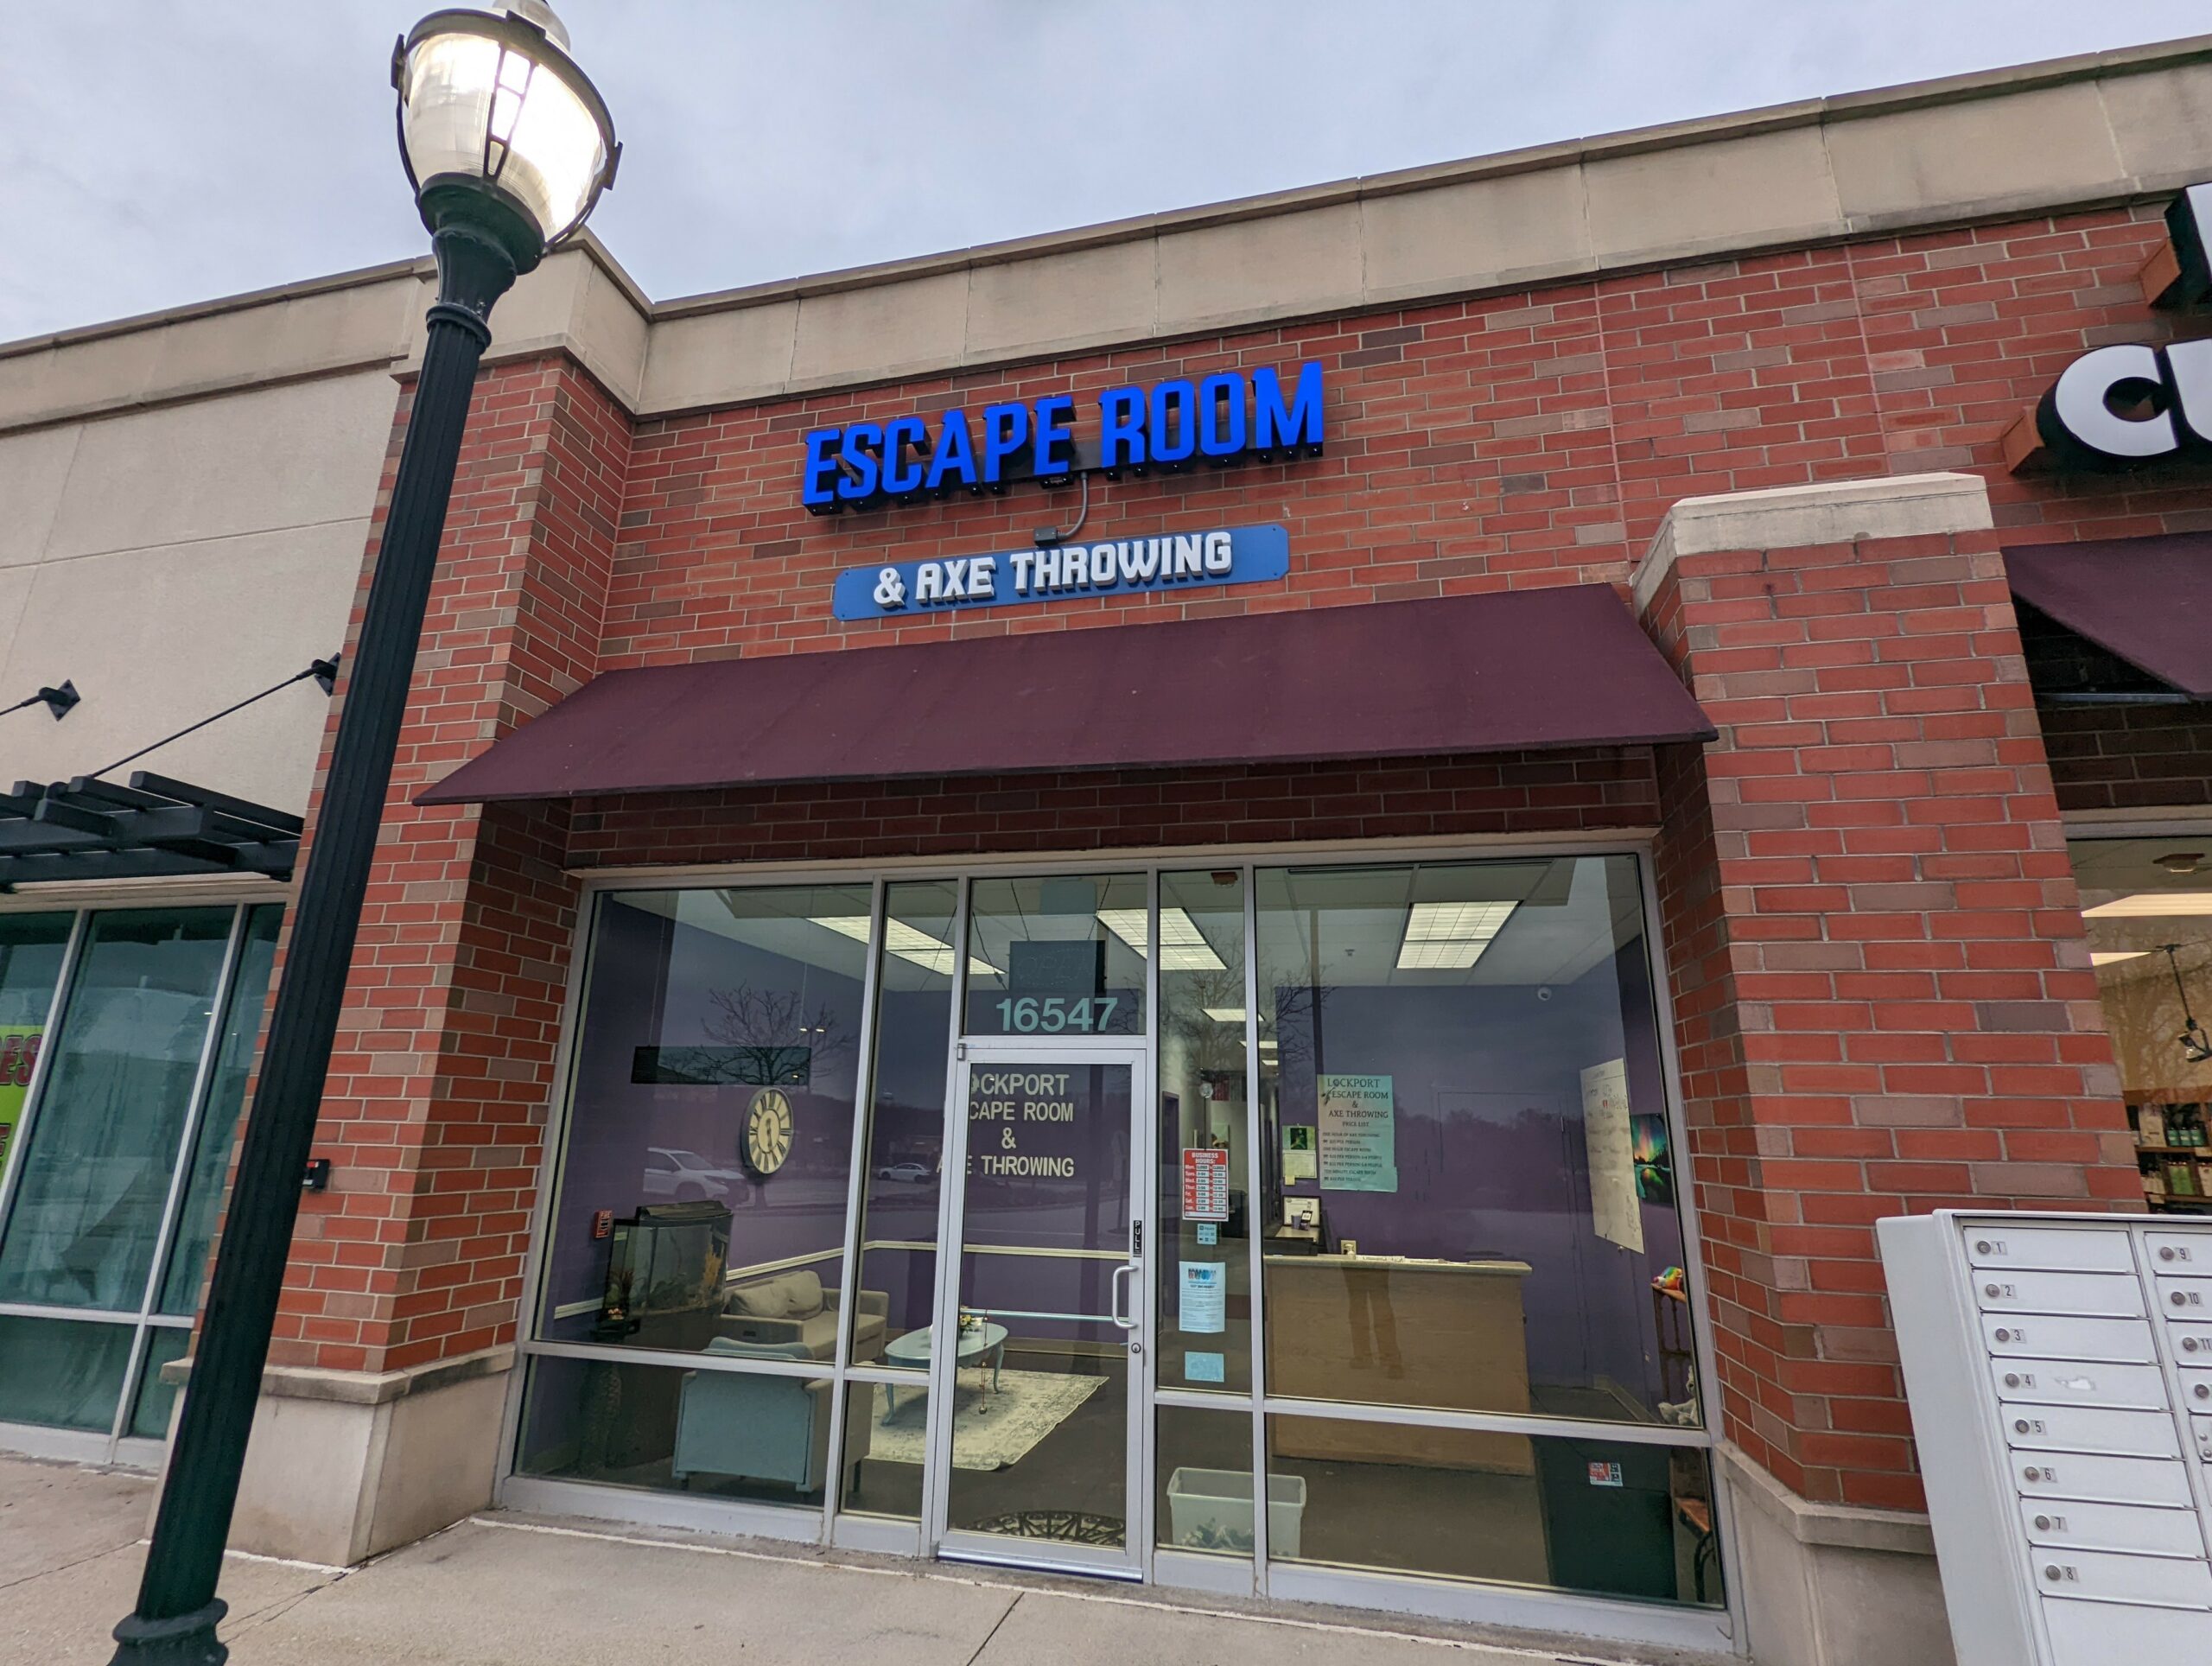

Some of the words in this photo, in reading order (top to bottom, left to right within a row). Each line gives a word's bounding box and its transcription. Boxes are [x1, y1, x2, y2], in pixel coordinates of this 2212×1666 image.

[803, 395, 1075, 508] ESCAPE
[1098, 361, 1324, 468] ROOM
[872, 566, 906, 607] &
[915, 556, 996, 604] AXE
[1009, 531, 1233, 595] THROWING
[996, 997, 1118, 1033] 16547
[970, 1073, 1070, 1096] OCKPORT
[1327, 1078, 1381, 1088] LOCKPORT
[1332, 1091, 1362, 1099] ESCAPE
[969, 1101, 1016, 1121] CAPE
[1023, 1102, 1074, 1122] ROOM
[1345, 1110, 1389, 1119] THROWING
[1001, 1127, 1017, 1149] &
[981, 1155, 1074, 1177] THROWING
[2179, 1248, 2186, 1260] 9
[2005, 1285, 2012, 1296] 2
[2189, 1293, 2199, 1305] 10
[2014, 1329, 2021, 1340] 3
[2024, 1375, 2031, 1386] 4
[2034, 1421, 2042, 1433] 5
[2044, 1468, 2051, 1480] 6
[2055, 1517, 2061, 1529] 7
[2067, 1567, 2074, 1580] 8
